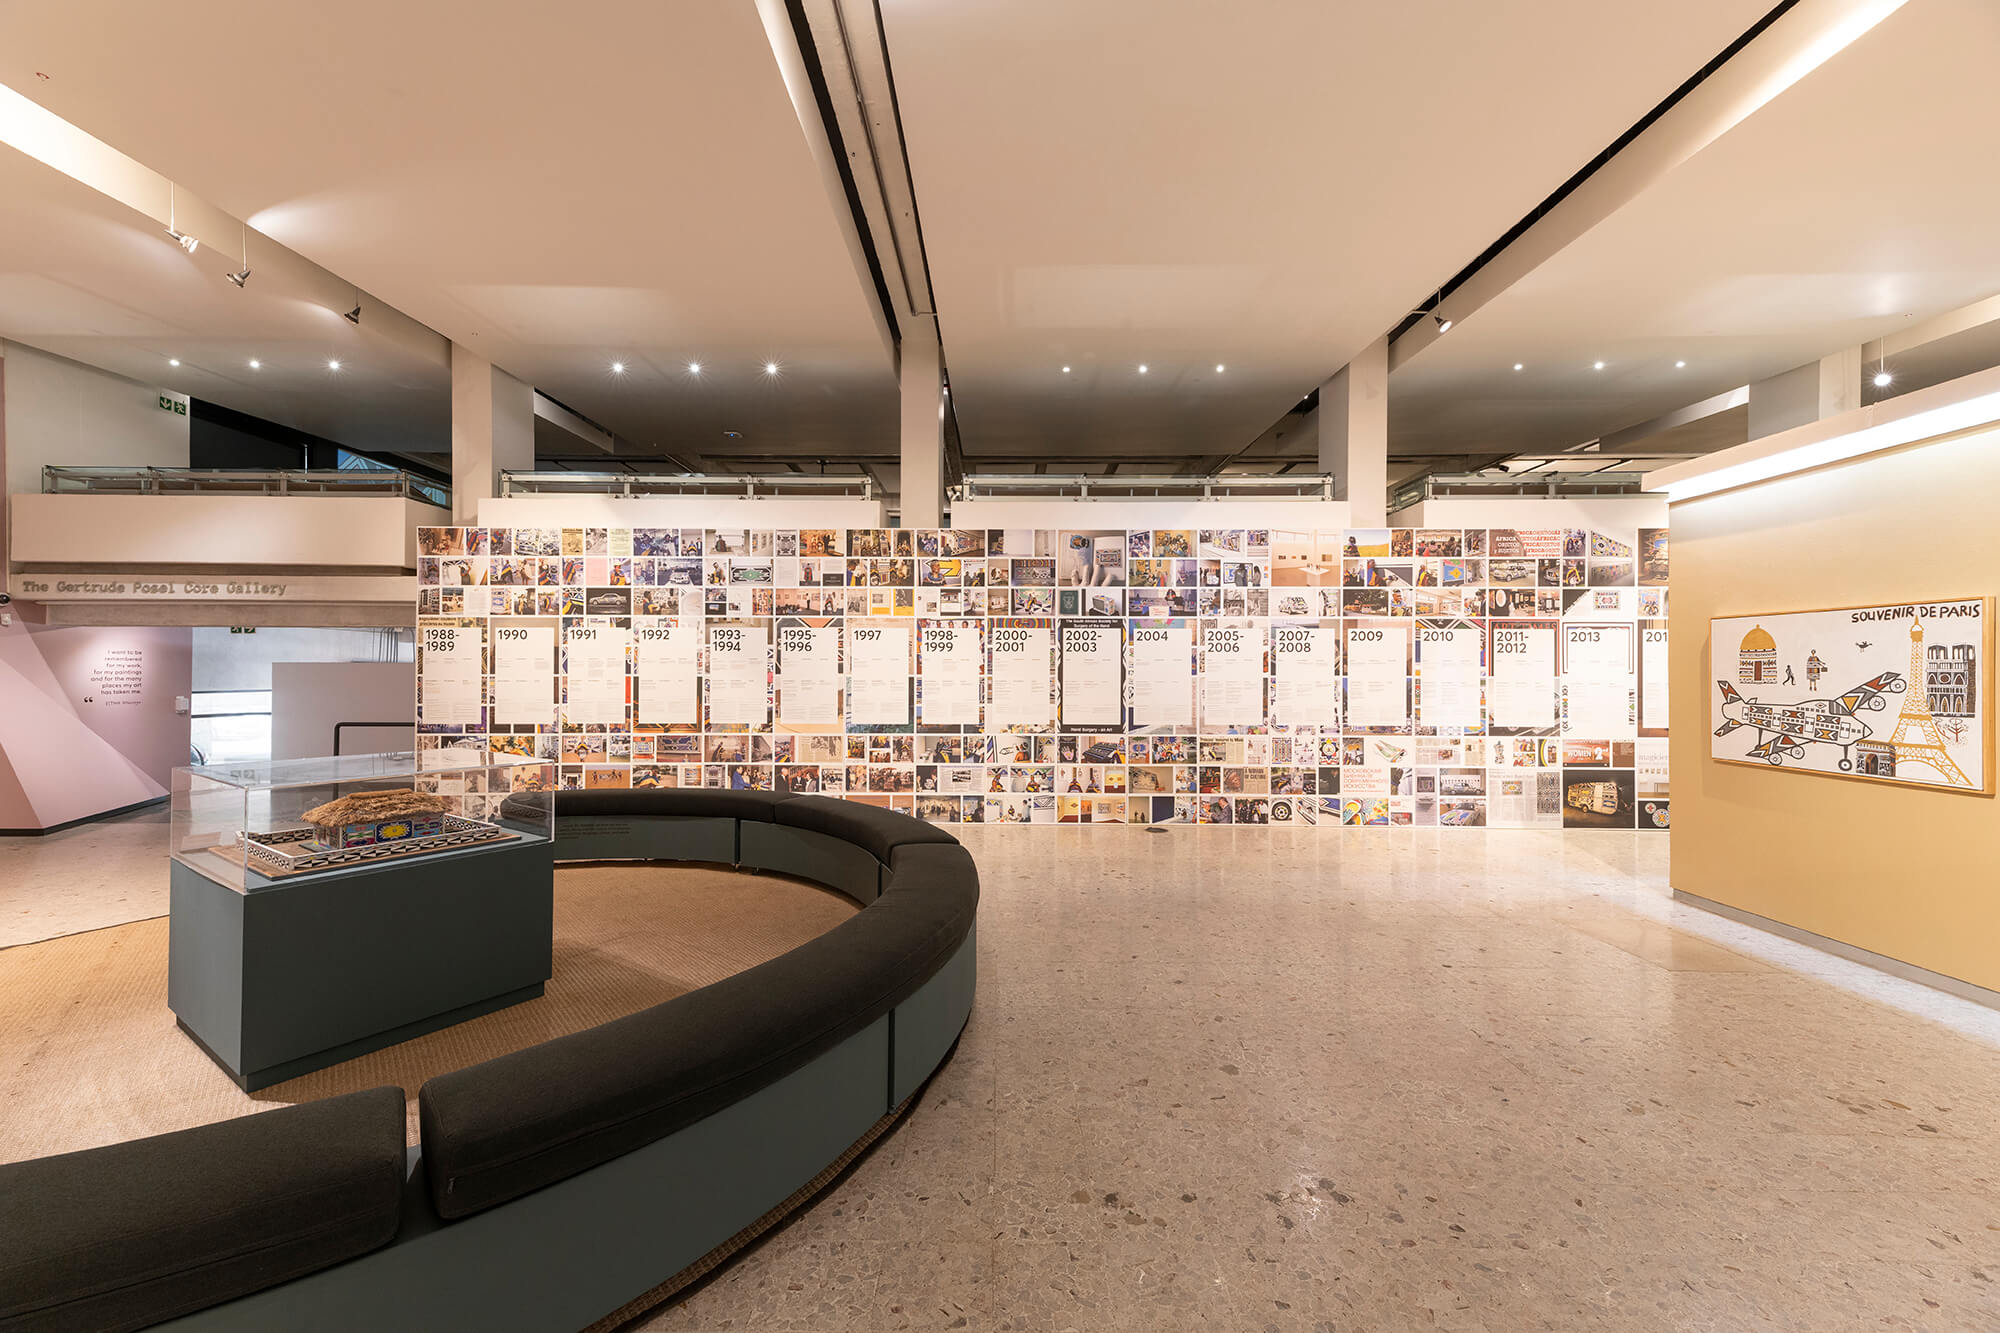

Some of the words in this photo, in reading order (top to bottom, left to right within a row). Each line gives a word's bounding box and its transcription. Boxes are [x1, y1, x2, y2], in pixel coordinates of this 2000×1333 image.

[23, 581, 49, 592] The
[57, 581, 125, 593] Gertrude
[132, 582, 176, 594] Posel
[184, 582, 219, 594] Core
[226, 581, 287, 596] Gallery
[1851, 606, 1915, 623] SOUVENIR
[1920, 606, 1937, 618] DE
[1939, 604, 1981, 618] PARIS
[426, 629, 460, 640] 1988-
[498, 629, 528, 640] 1990
[570, 630, 597, 640] 1991
[641, 630, 670, 640] 1992
[713, 629, 746, 640] 1993-
[783, 630, 816, 640] 1995-
[854, 630, 881, 640] 1997
[925, 630, 958, 641] 1998-
[995, 630, 1032, 640] 2000-
[1066, 630, 1102, 641] 2002-
[1137, 631, 1168, 641] 2004
[1208, 631, 1244, 641] 2005-
[1279, 631, 1315, 641] 2007-
[1351, 631, 1383, 641] 2009
[1424, 631, 1453, 641] 2010
[1497, 631, 1528, 641] 2011-
[1571, 632, 1600, 642] 2013
[1646, 632, 1667, 642] 201
[426, 641, 454, 651] 1989
[713, 641, 741, 652] 1994
[783, 641, 812, 652] 1996
[925, 642, 953, 652] 1999
[996, 642, 1024, 652] 2001
[1066, 642, 1097, 652] 2003
[1208, 642, 1239, 652] 2006
[1279, 642, 1311, 652] 2008
[1497, 643, 1526, 653] 2012
